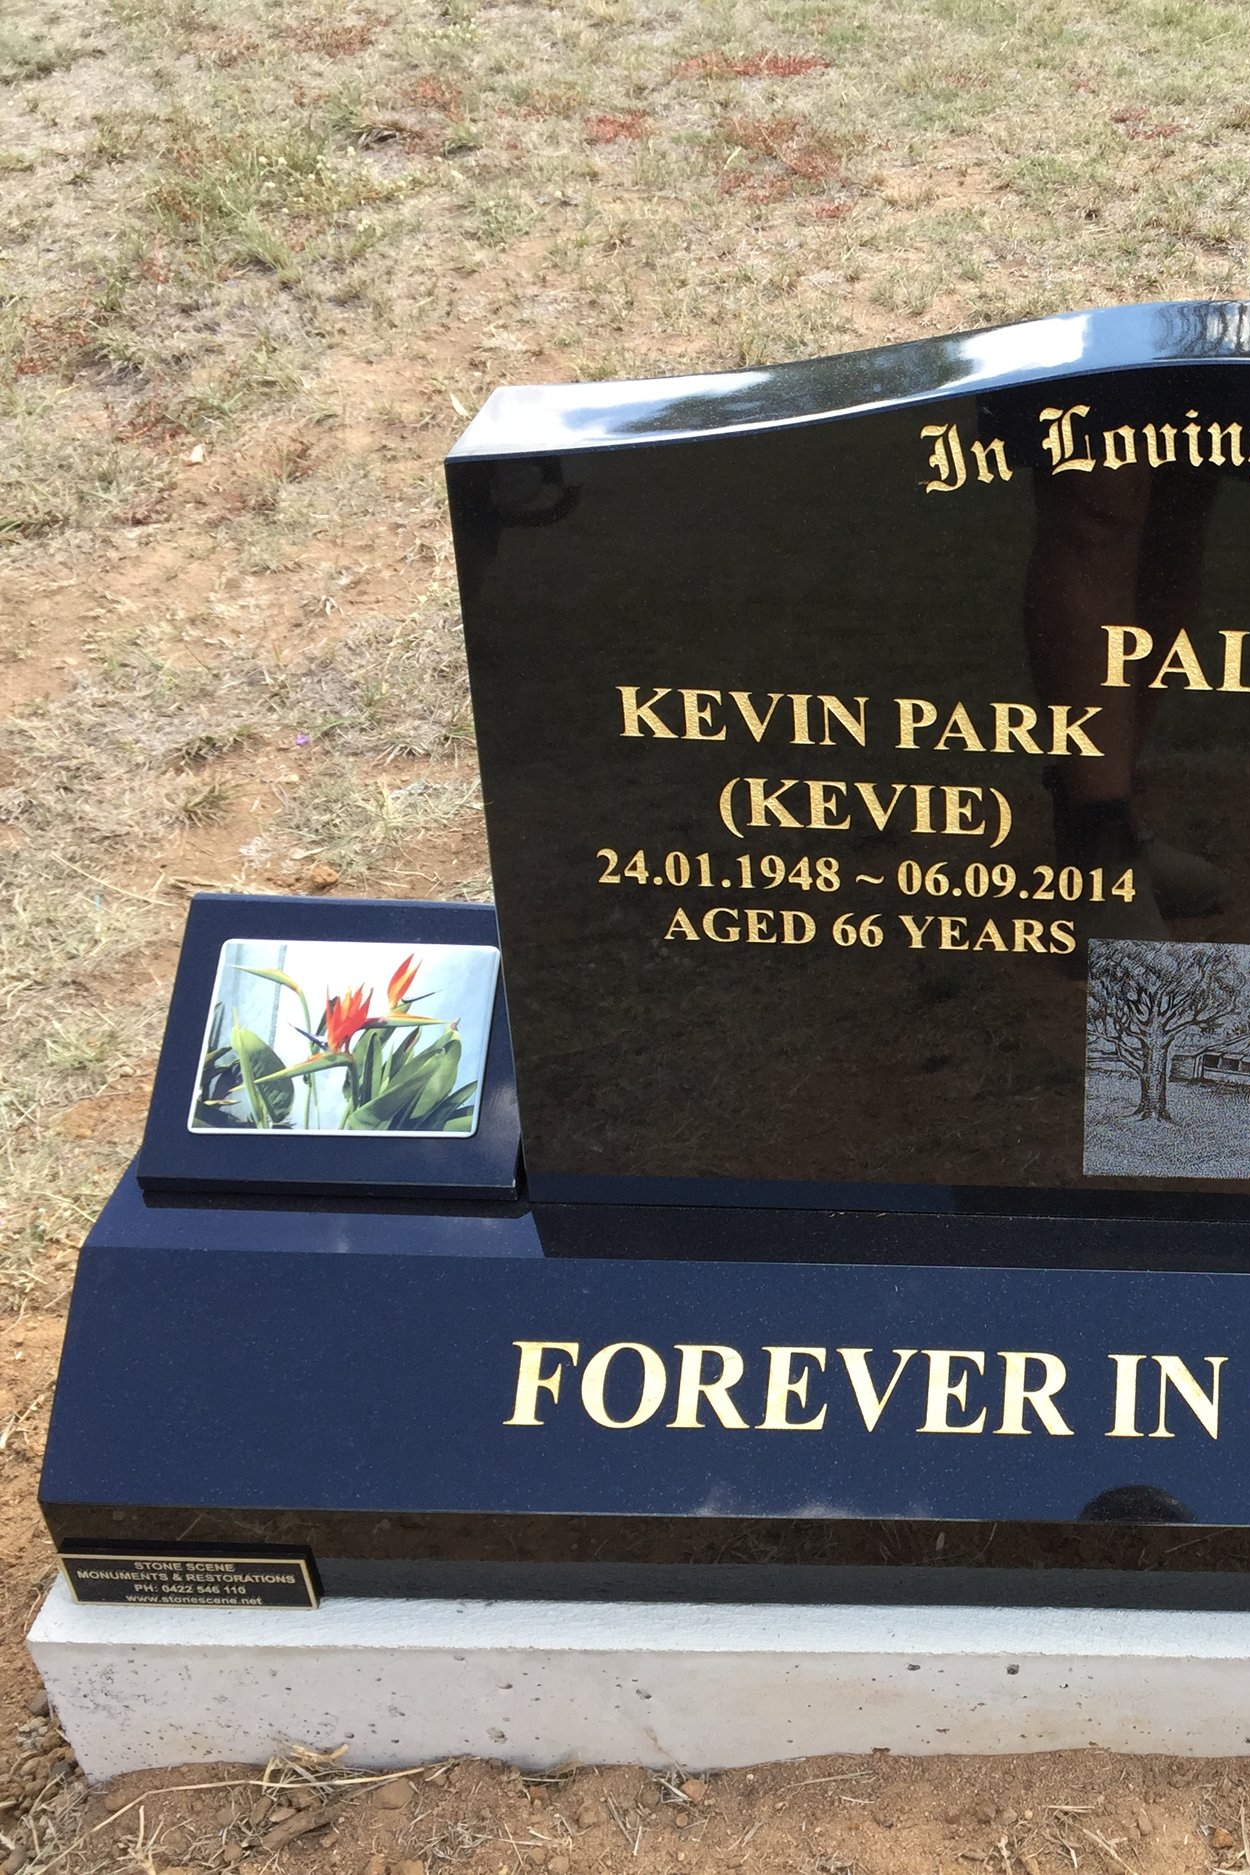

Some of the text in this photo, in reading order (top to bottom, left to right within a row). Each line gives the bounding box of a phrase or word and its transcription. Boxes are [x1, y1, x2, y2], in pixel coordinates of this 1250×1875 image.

[920, 423, 1013, 494] In
[615, 686, 1105, 757] KEVIN PARK
[719, 777, 1013, 848] (KEVIE)
[596, 848, 841, 892] 24.01.1948
[897, 860, 1136, 903] 06.09.2014
[664, 907, 1076, 954] AGED 66 YEARS
[502, 1341, 1075, 1436] FOREVER
[1104, 1354, 1229, 1440] IN
[77, 1570, 296, 1584] MONUMENTS & RESTORATIONS
[134, 1562, 235, 1572] STONE SCENE
[134, 1584, 247, 1595] PH: 0422 546 110
[125, 1594, 263, 1605] www.stonescene.net
